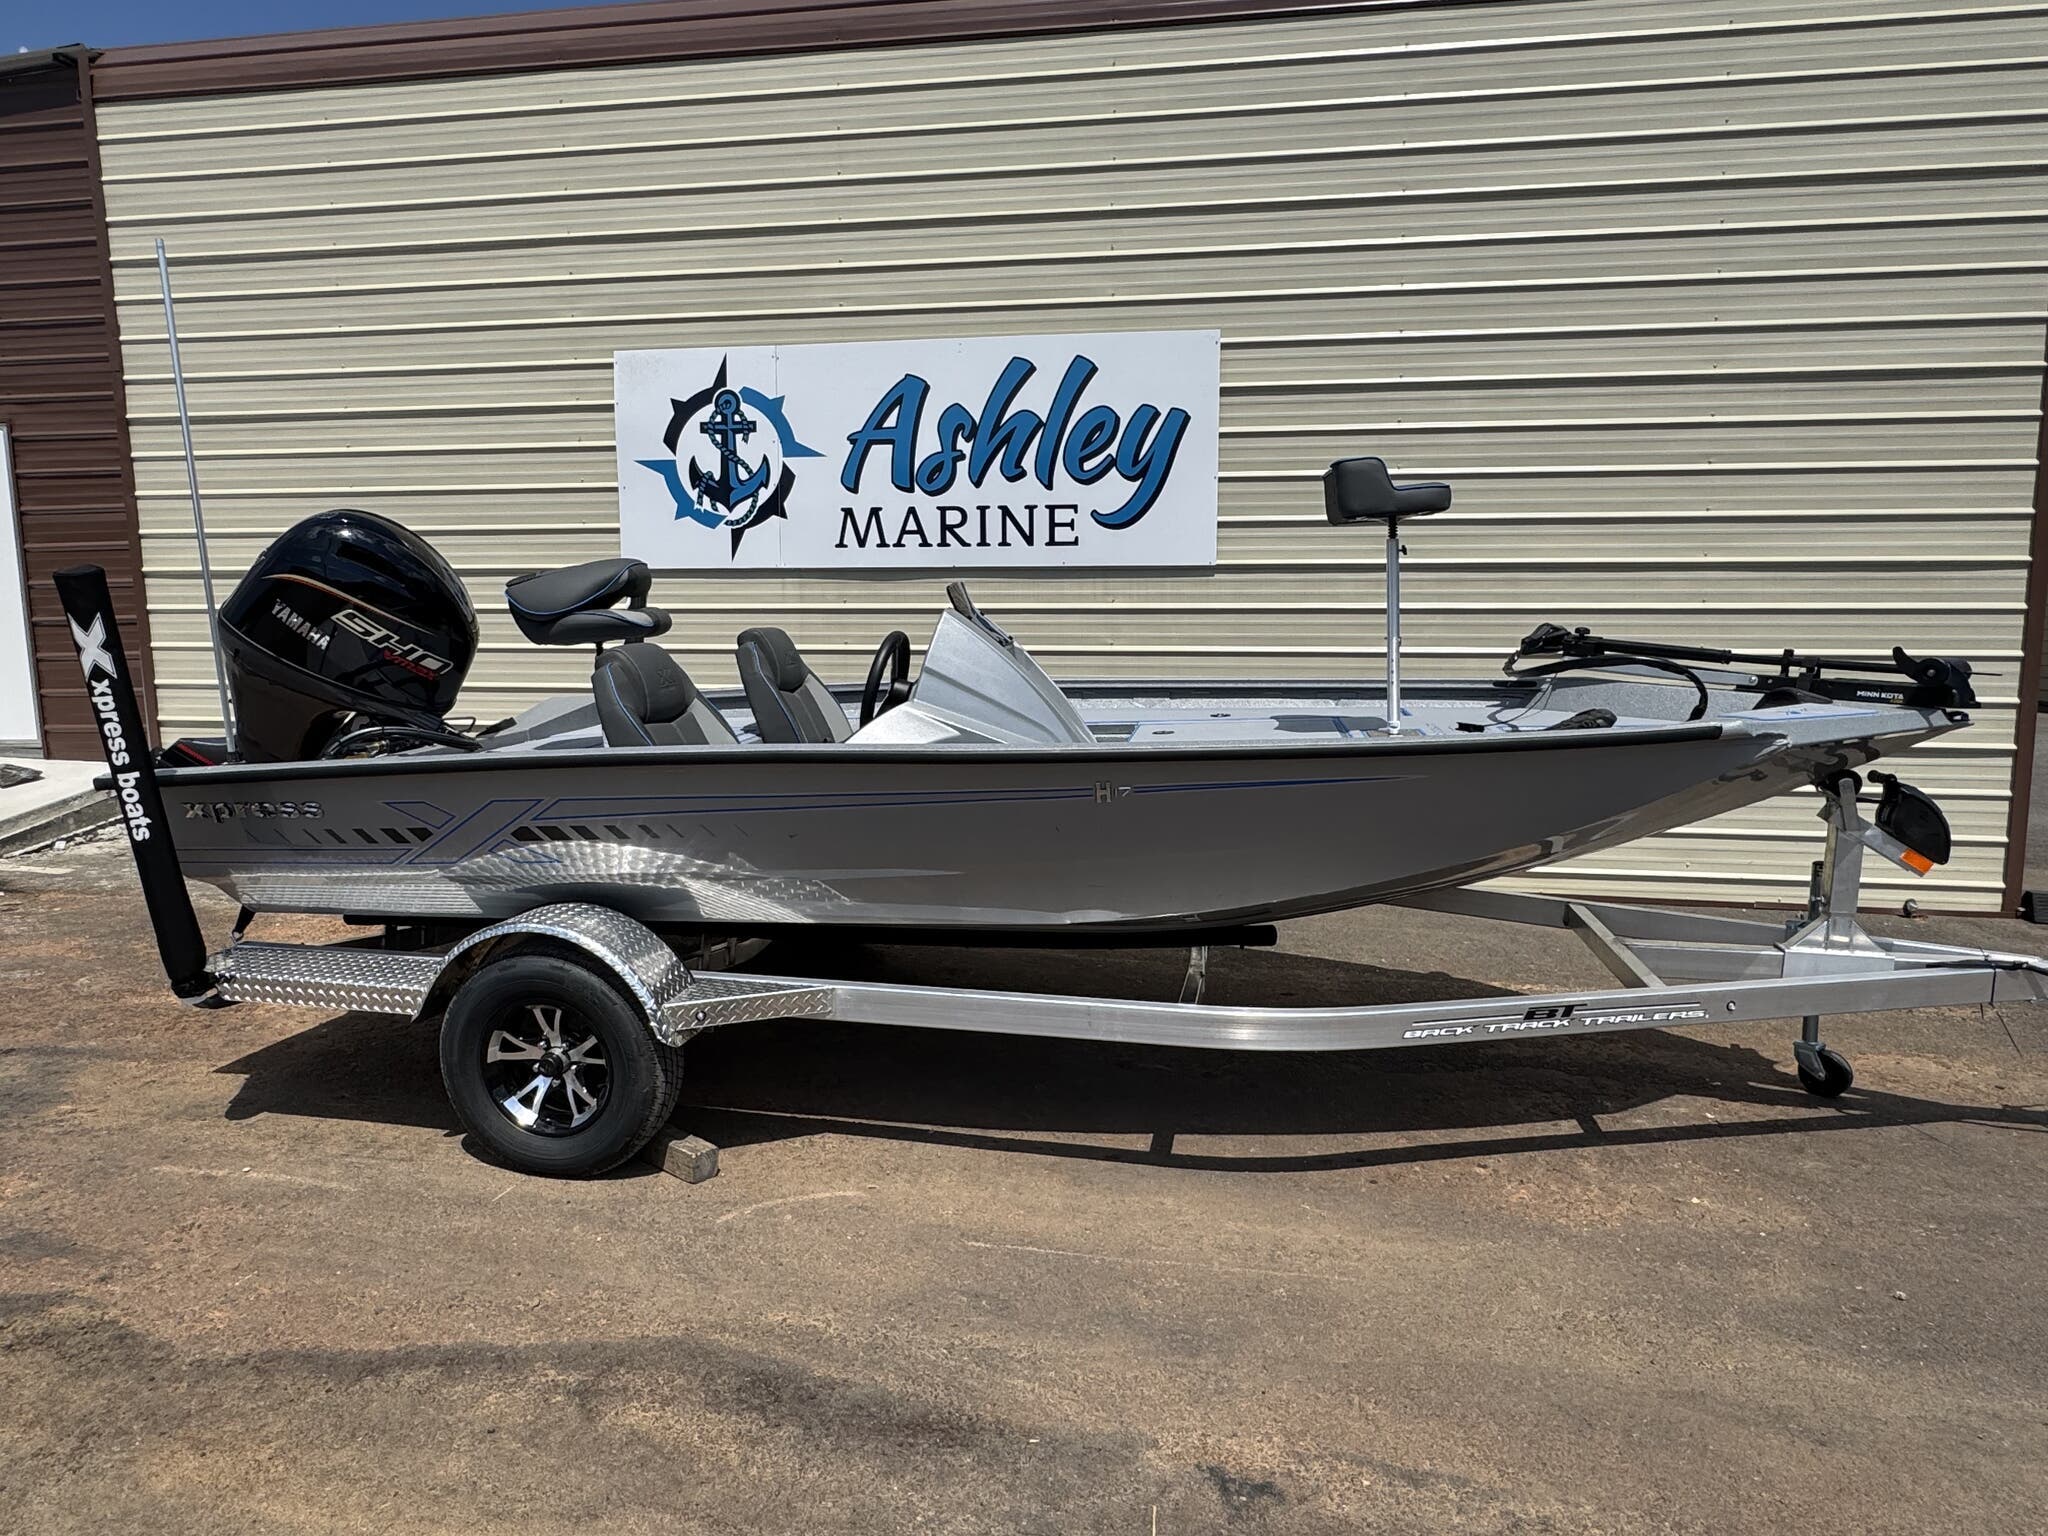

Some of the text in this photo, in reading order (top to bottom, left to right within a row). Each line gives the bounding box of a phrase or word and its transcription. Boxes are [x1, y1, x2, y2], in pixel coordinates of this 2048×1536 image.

[841, 354, 1191, 531] Ashley
[835, 504, 1079, 549] MARINE
[271, 598, 331, 650] YAMAHA
[330, 609, 454, 675] SHO
[1856, 690, 1904, 700] MINN KOTA
[91, 678, 152, 842] xpress boats
[1402, 1024, 1477, 1040] BACK
[1484, 1017, 1572, 1034] TRACK
[1523, 1003, 1587, 1021] BT
